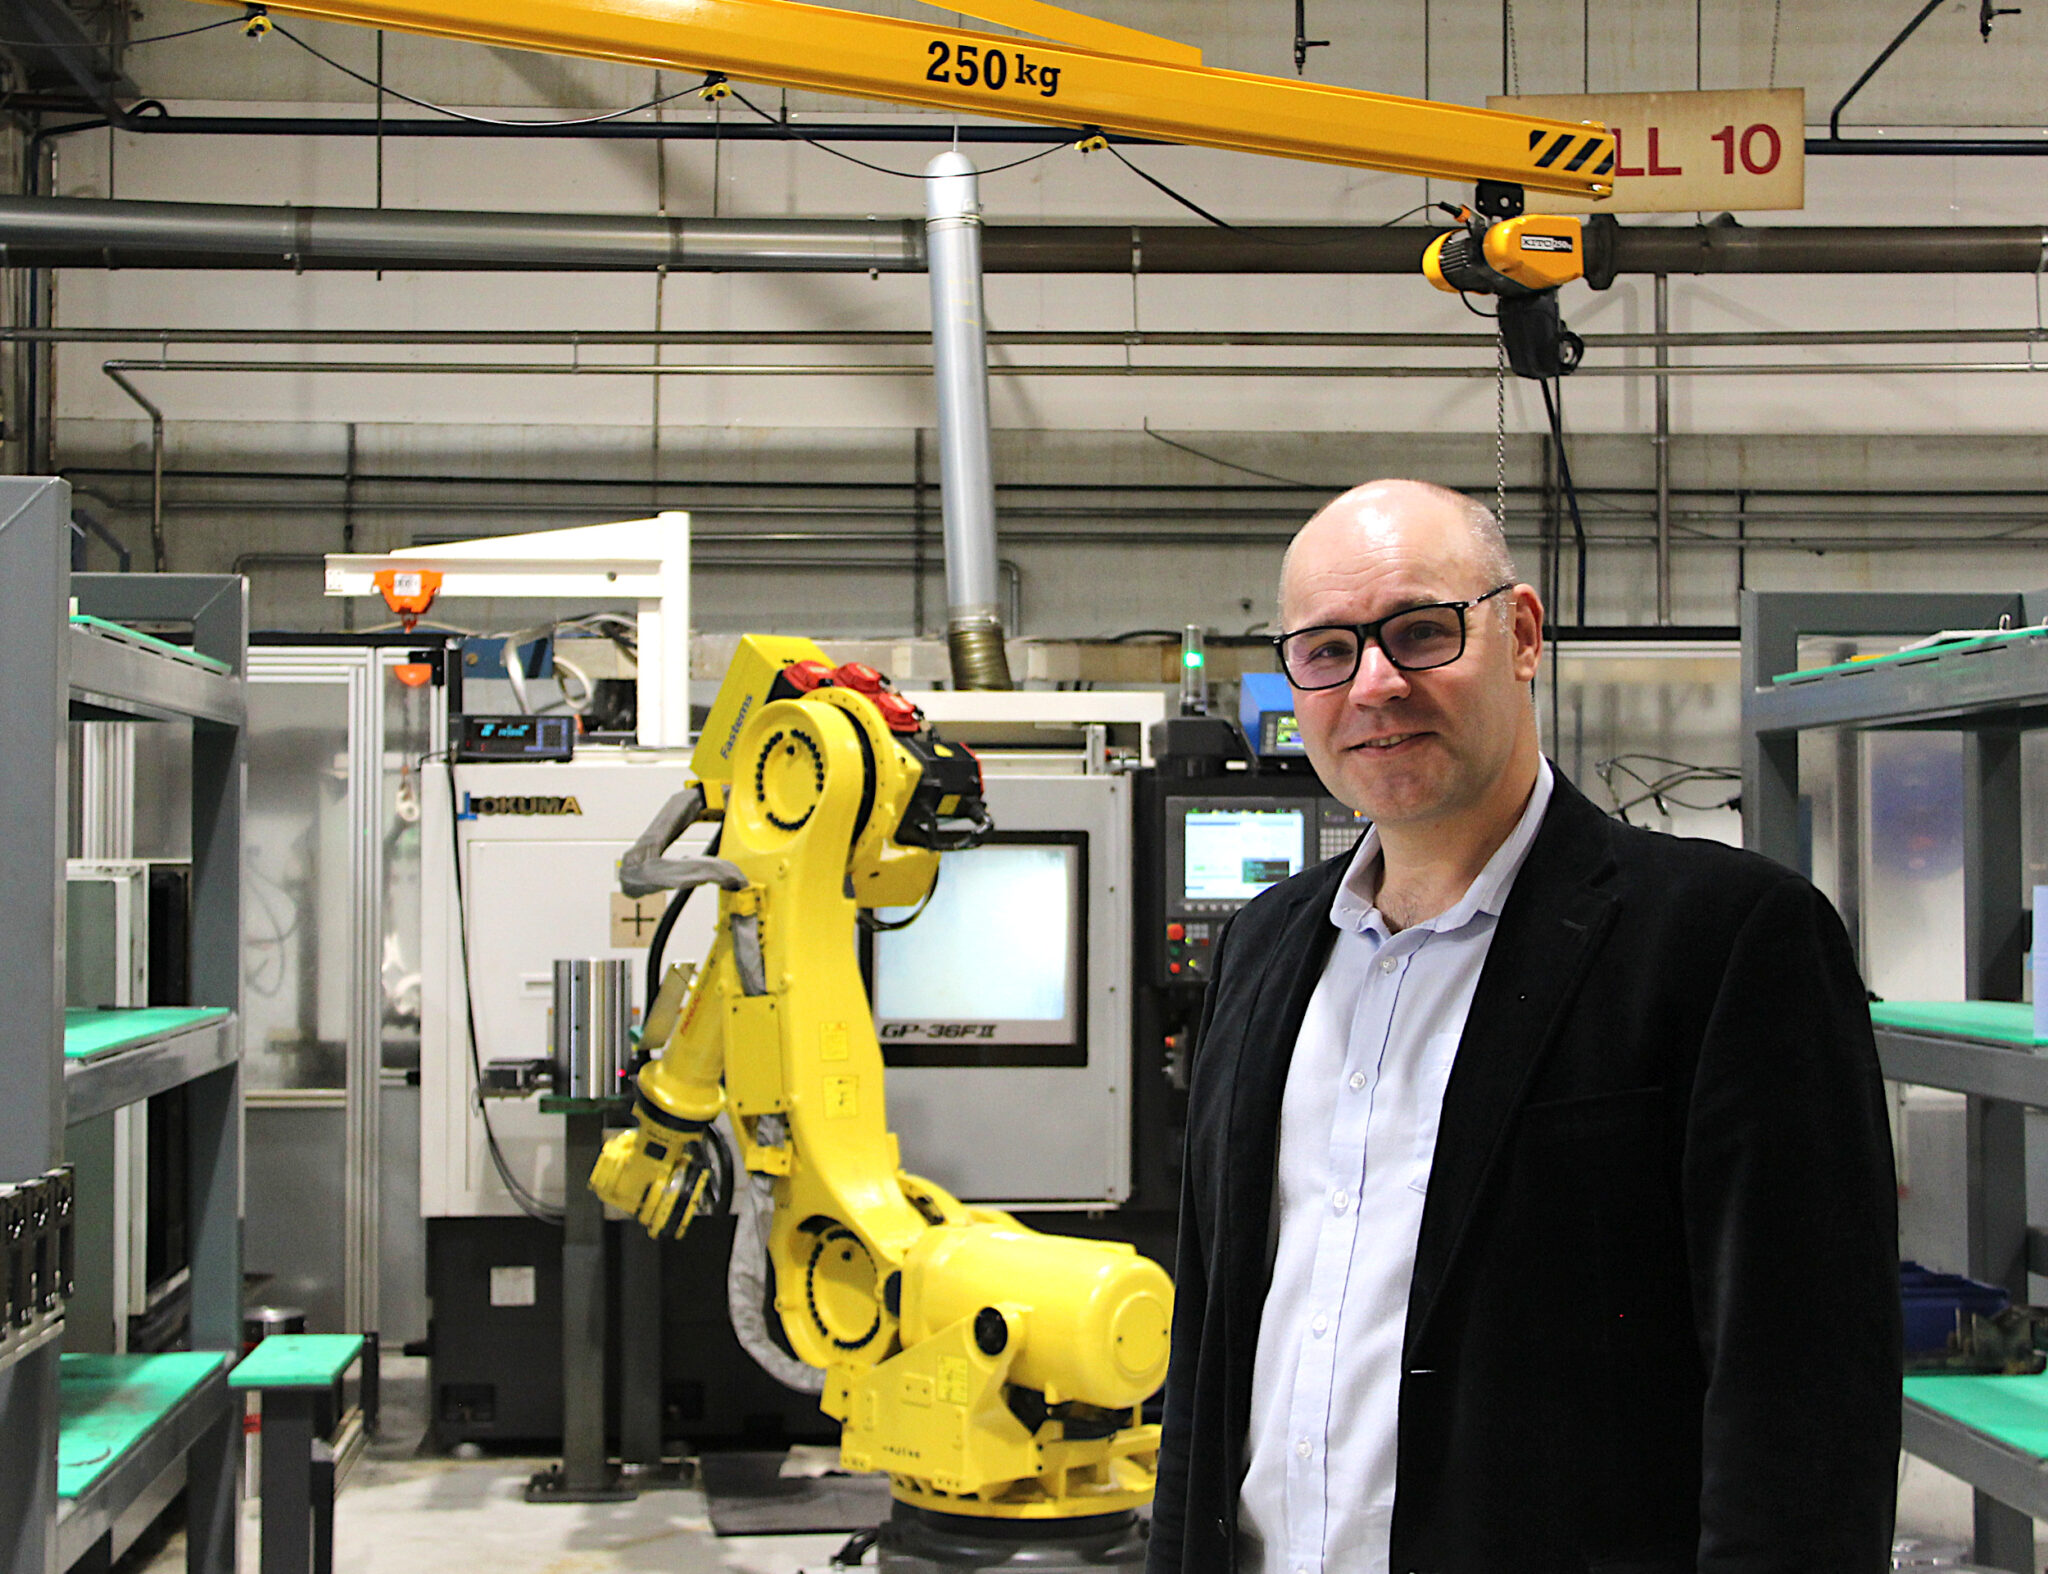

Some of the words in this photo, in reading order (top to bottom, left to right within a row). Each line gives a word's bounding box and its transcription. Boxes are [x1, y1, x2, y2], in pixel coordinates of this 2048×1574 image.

[926, 40, 1007, 90] 250
[1014, 53, 1061, 97] kg
[1611, 127, 1682, 176] LL
[1710, 123, 1781, 175] 10
[720, 693, 753, 760] Fastems
[480, 796, 582, 816] OKUMA
